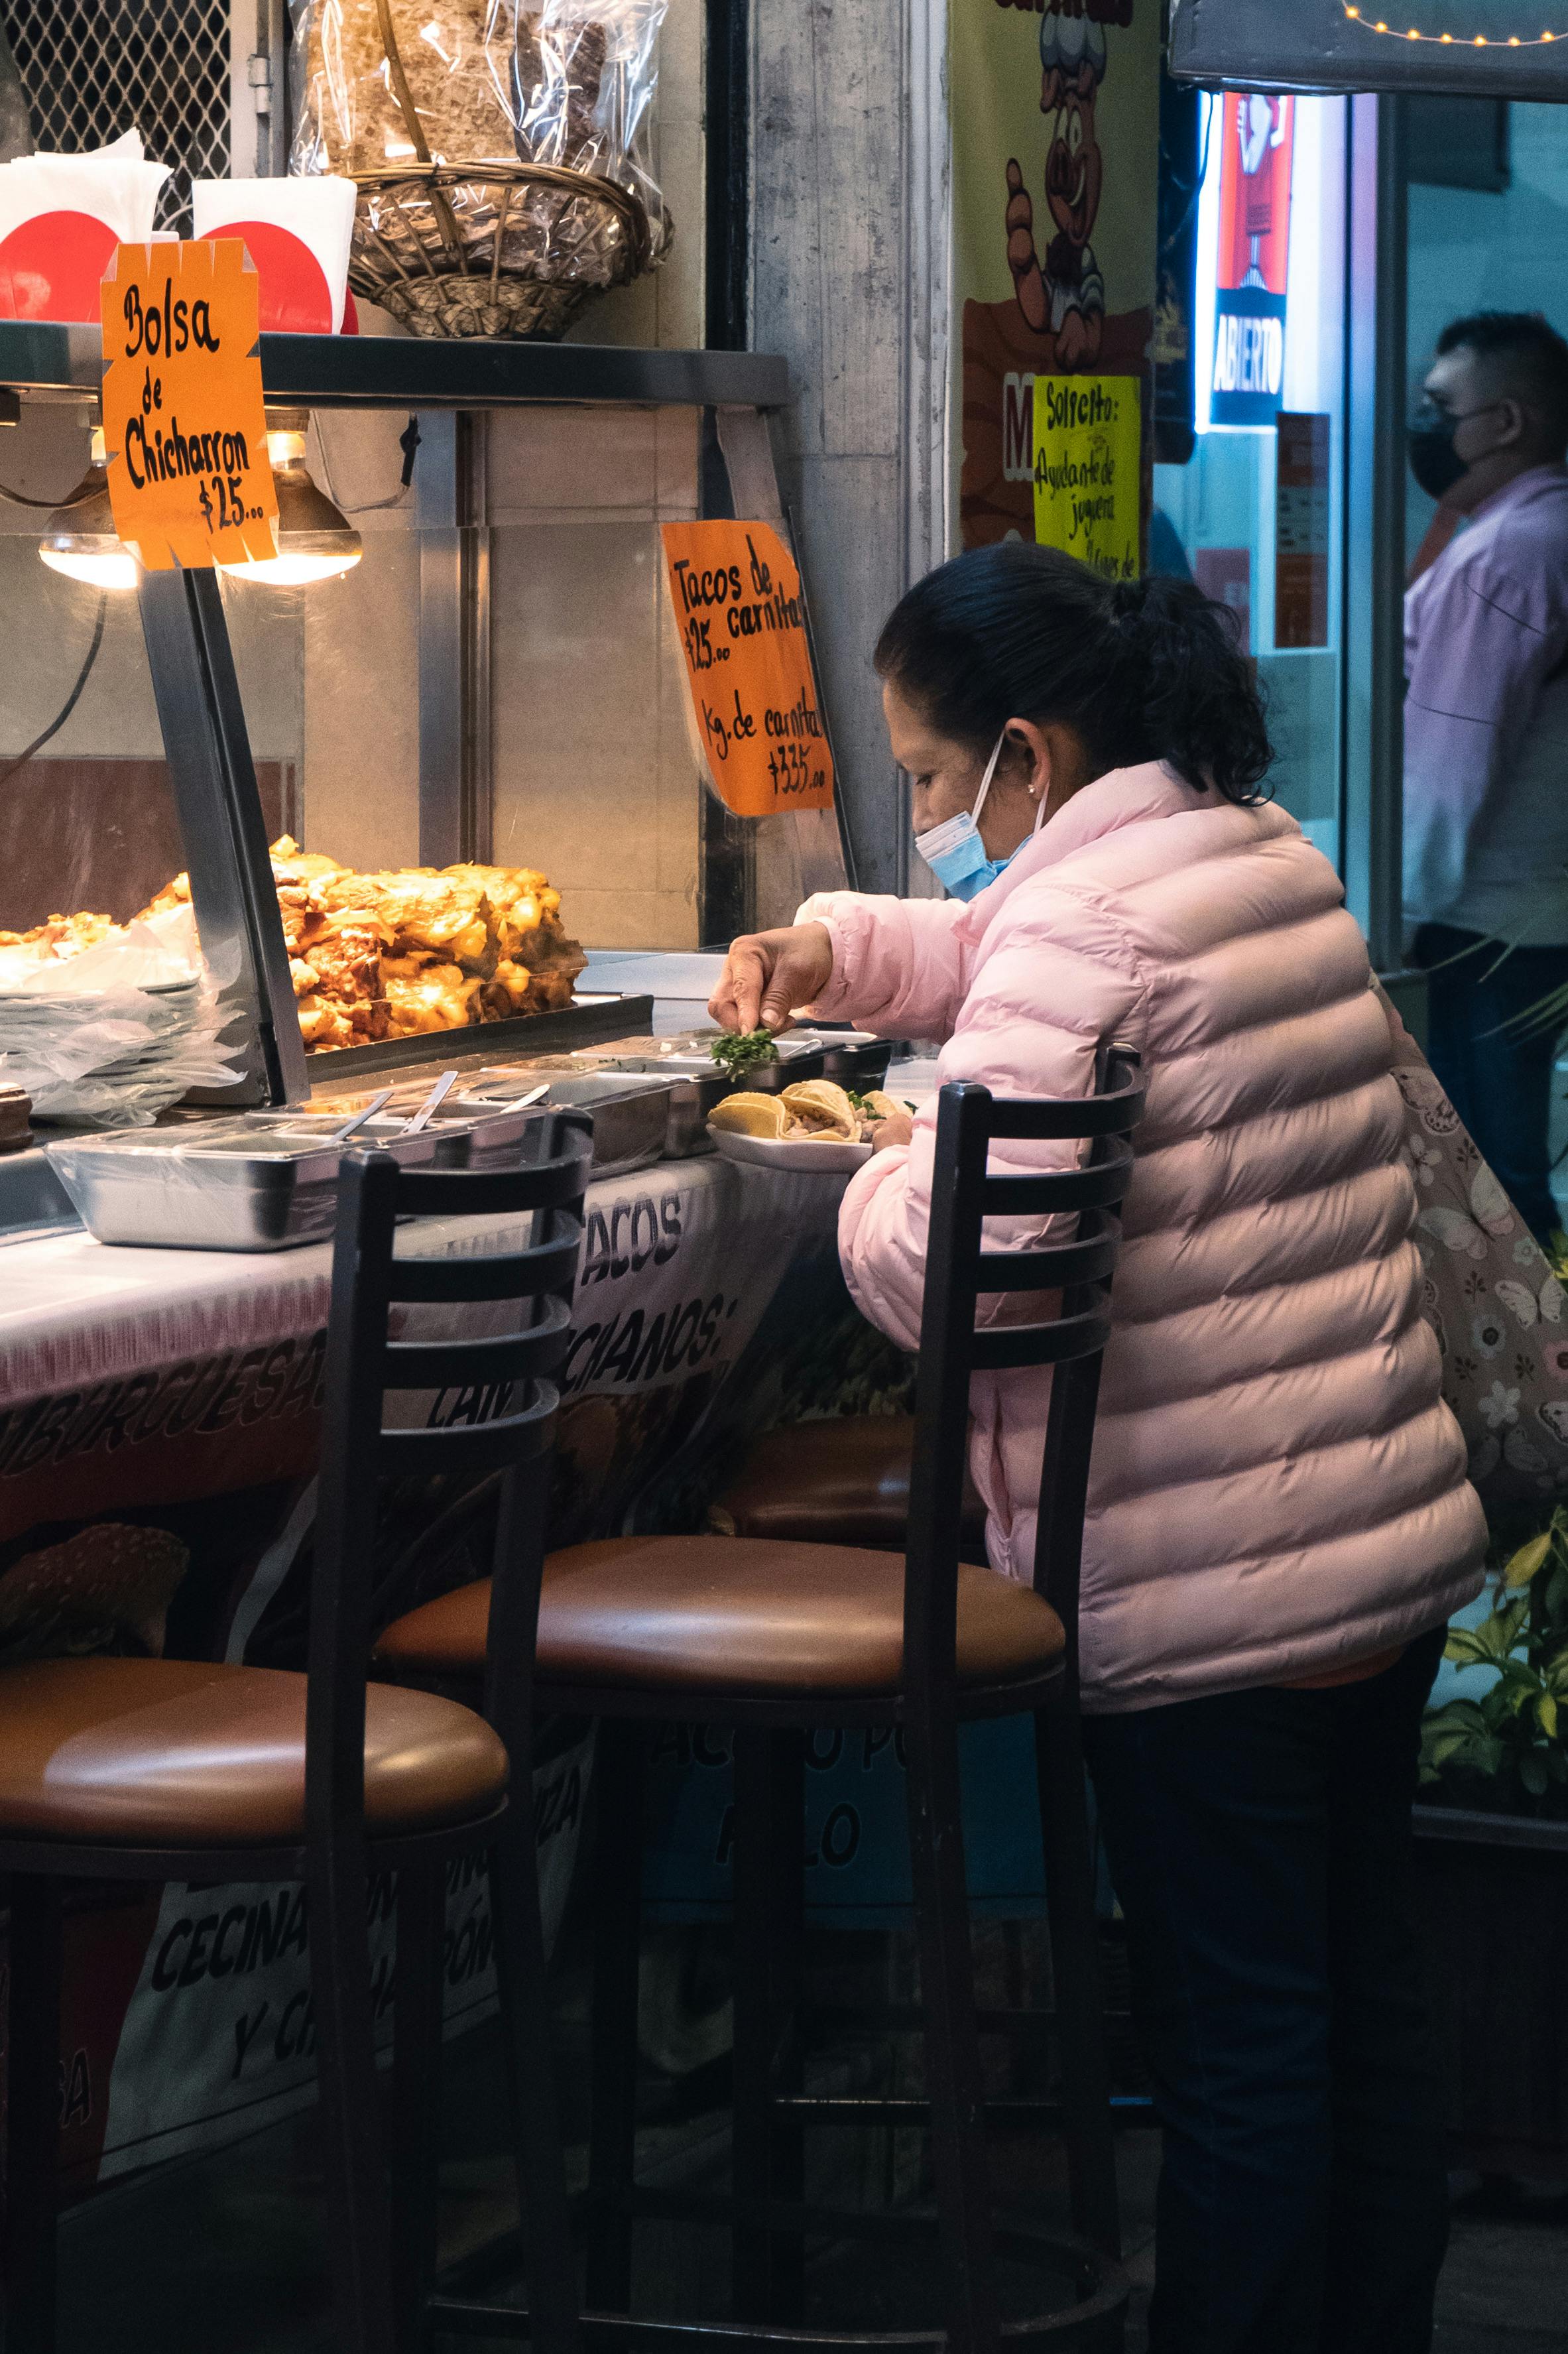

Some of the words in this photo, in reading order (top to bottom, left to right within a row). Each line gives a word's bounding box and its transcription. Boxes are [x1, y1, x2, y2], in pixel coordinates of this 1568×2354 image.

[124, 278, 220, 359] Bolsa
[1213, 314, 1283, 395] ABIERTO
[142, 365, 162, 415] de
[125, 414, 249, 489] Chicharron
[674, 559, 742, 614] Tacos
[745, 534, 772, 596] de
[581, 1193, 682, 1286] ACOS
[232, 2000, 269, 2079] Y
